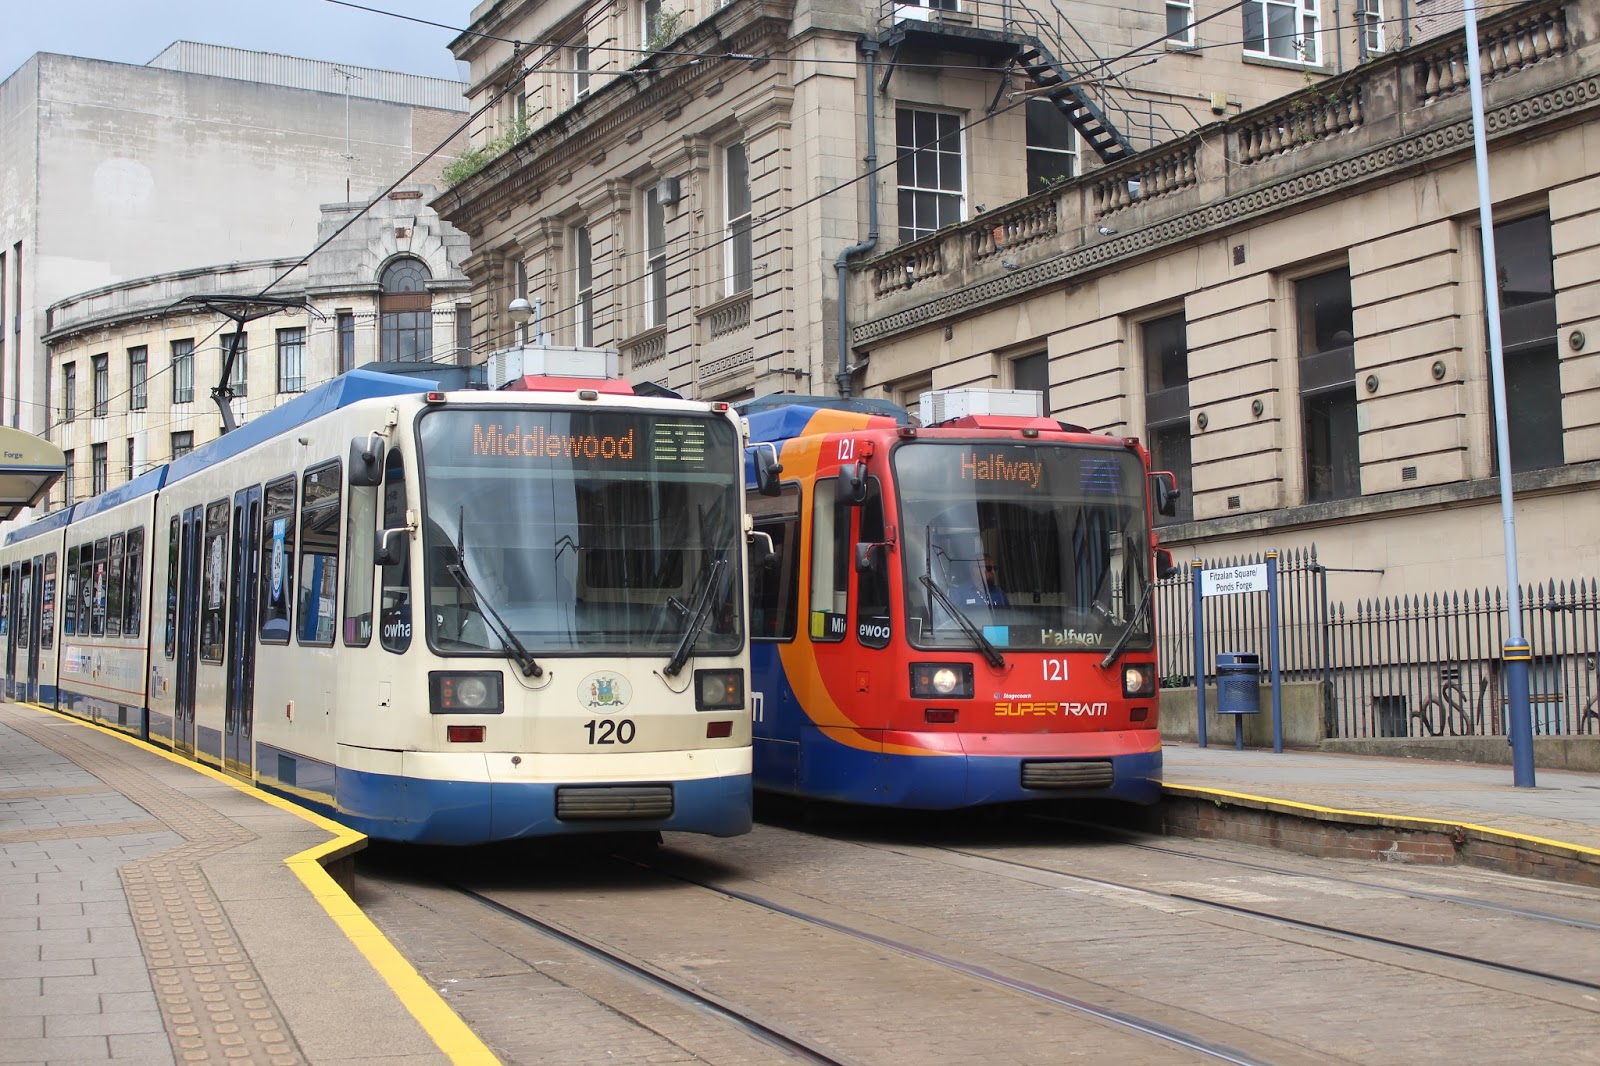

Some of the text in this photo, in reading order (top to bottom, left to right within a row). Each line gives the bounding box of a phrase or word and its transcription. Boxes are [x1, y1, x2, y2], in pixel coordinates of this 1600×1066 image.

[473, 424, 633, 459] Middlewood
[838, 438, 855, 460] 121
[4, 451, 23, 459] Forge
[960, 452, 1042, 488] Halfway
[1209, 571, 1233, 581] Fitzalan
[1216, 581, 1253, 592] Ponds Forge
[1043, 659, 1068, 681] 121
[1003, 692, 1032, 700] Stagecoach
[584, 719, 636, 745] 120
